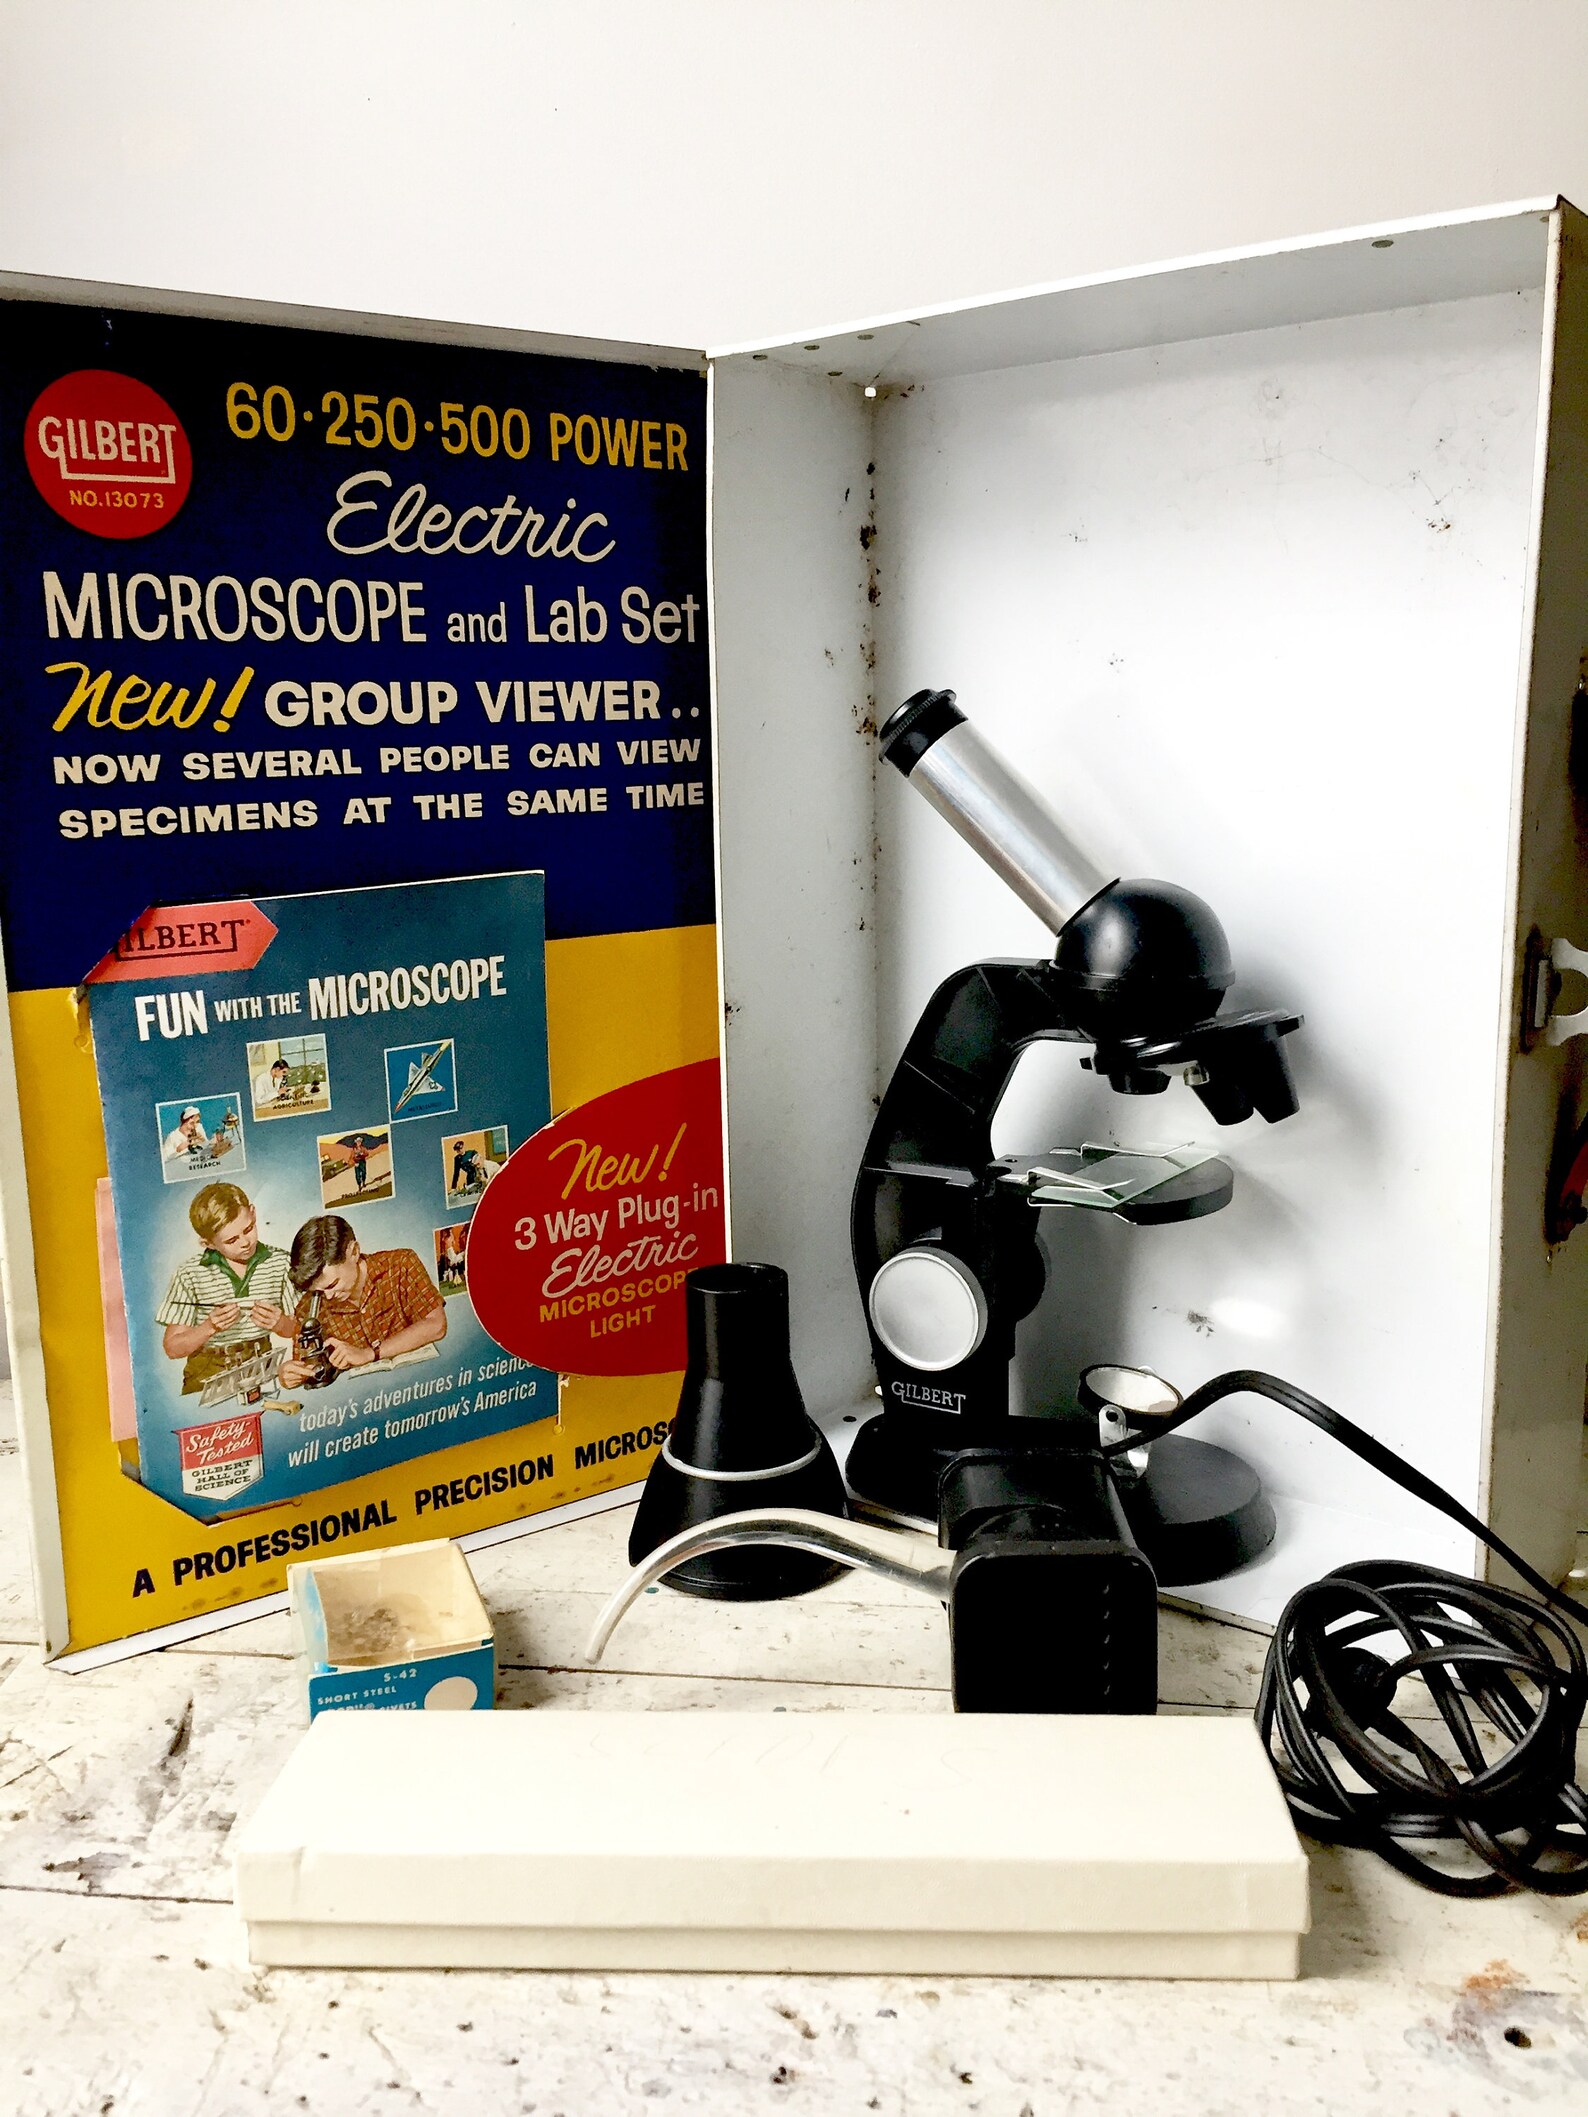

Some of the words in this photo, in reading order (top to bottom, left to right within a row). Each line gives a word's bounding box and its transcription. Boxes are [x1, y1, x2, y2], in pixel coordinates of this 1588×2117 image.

[38, 416, 176, 484] GILBERT
[550, 413, 689, 471] POWER
[326, 470, 616, 563] Electric
[43, 571, 427, 643] MICROSCOPE
[447, 602, 508, 643] and
[525, 585, 608, 644] Lab
[621, 585, 700, 644] Set
[264, 680, 458, 727] GROUP
[53, 753, 161, 785] NOW
[183, 748, 361, 781] SEVERAL
[380, 743, 509, 774] PEOPLE
[529, 740, 600, 770] CAN
[616, 738, 701, 766] VIEW
[58, 798, 319, 839] SPECIMENS
[343, 796, 391, 825] AT
[413, 792, 484, 821] THE
[507, 786, 608, 816] SAME
[626, 782, 705, 809] TIME
[116, 919, 244, 961] ILBERT
[135, 990, 209, 1042] FUN
[214, 996, 263, 1023] WITH
[266, 991, 302, 1016] THE
[308, 955, 507, 1021] MICROSCOPE
[272, 1099, 314, 1111] AGRICULTURE
[188, 1161, 221, 1171] RESEARCH
[514, 1217, 537, 1250] 3
[544, 1208, 609, 1244] Way
[618, 1182, 718, 1230] Plug-in
[541, 1231, 699, 1298] Electric
[590, 1305, 656, 1338] LIGHT
[300, 1399, 358, 1432] today's
[364, 1376, 453, 1415] adventures
[458, 1367, 473, 1387] in
[891, 1381, 966, 1414] GILBERT
[288, 1441, 319, 1468] will
[325, 1427, 379, 1458] create
[385, 1396, 470, 1439] tomorrow's
[474, 1380, 537, 1412] America
[192, 1459, 253, 1478] GILBERT
[197, 1432, 254, 1465] Tested
[195, 1475, 251, 1492] SCIENCE
[197, 1472, 230, 1484] HALL
[234, 1468, 249, 1477] OF
[132, 1568, 155, 1598] A
[173, 1499, 397, 1586] PROFESSIONAL
[414, 1454, 554, 1516] PRECISION
[318, 1691, 358, 1705] SHORT
[363, 1686, 397, 1698] STEEL
